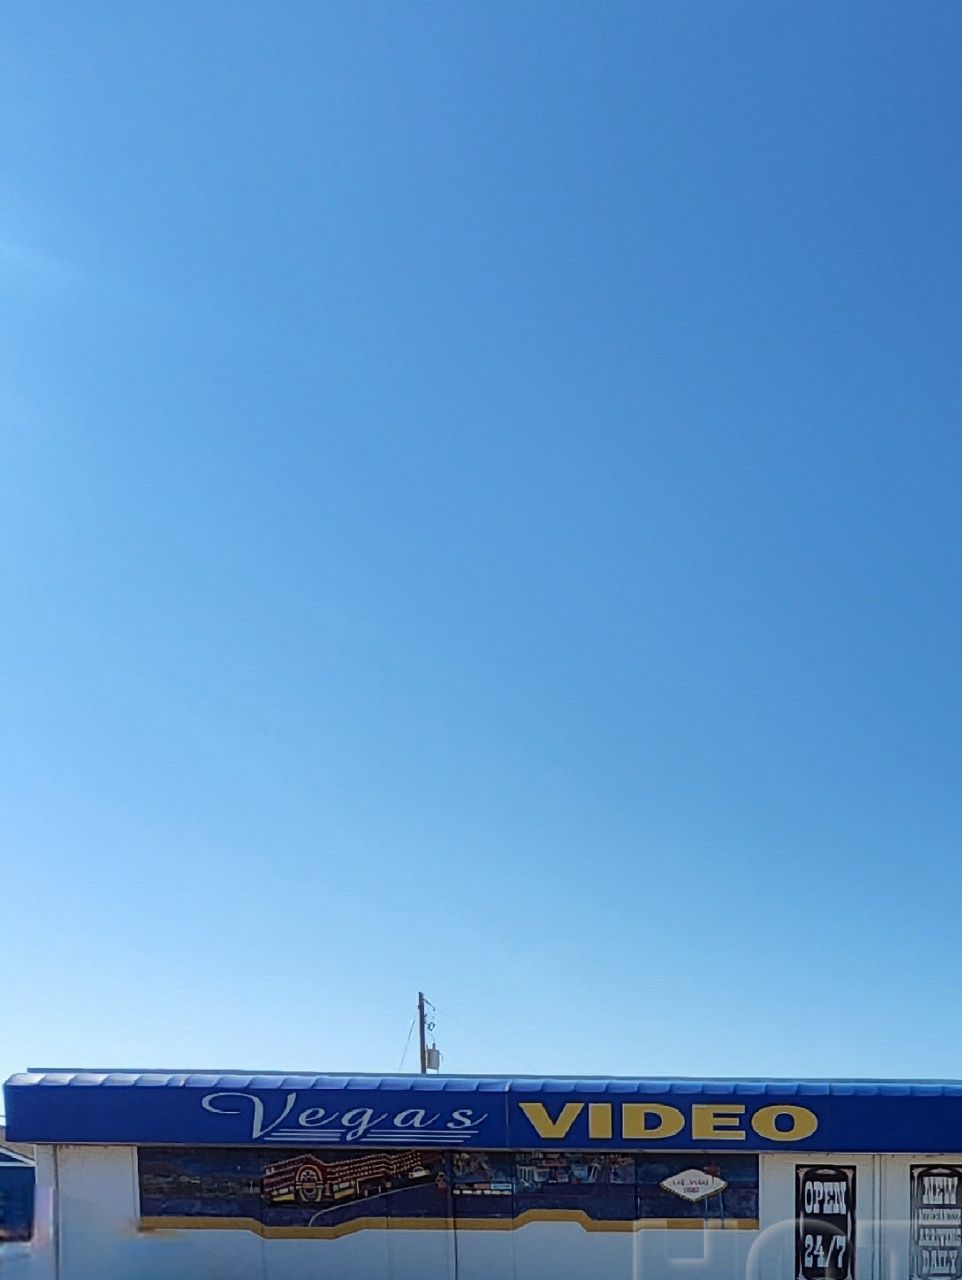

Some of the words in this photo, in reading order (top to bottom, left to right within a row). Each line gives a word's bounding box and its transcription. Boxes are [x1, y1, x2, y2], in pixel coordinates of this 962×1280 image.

[201, 1092, 488, 1142] Vegas
[518, 1102, 818, 1142] VIDEO
[804, 1180, 847, 1215] OPEN
[922, 1176, 959, 1205] NEW
[804, 1233, 847, 1269] 24/7
[921, 1249, 958, 1275] DAILY
